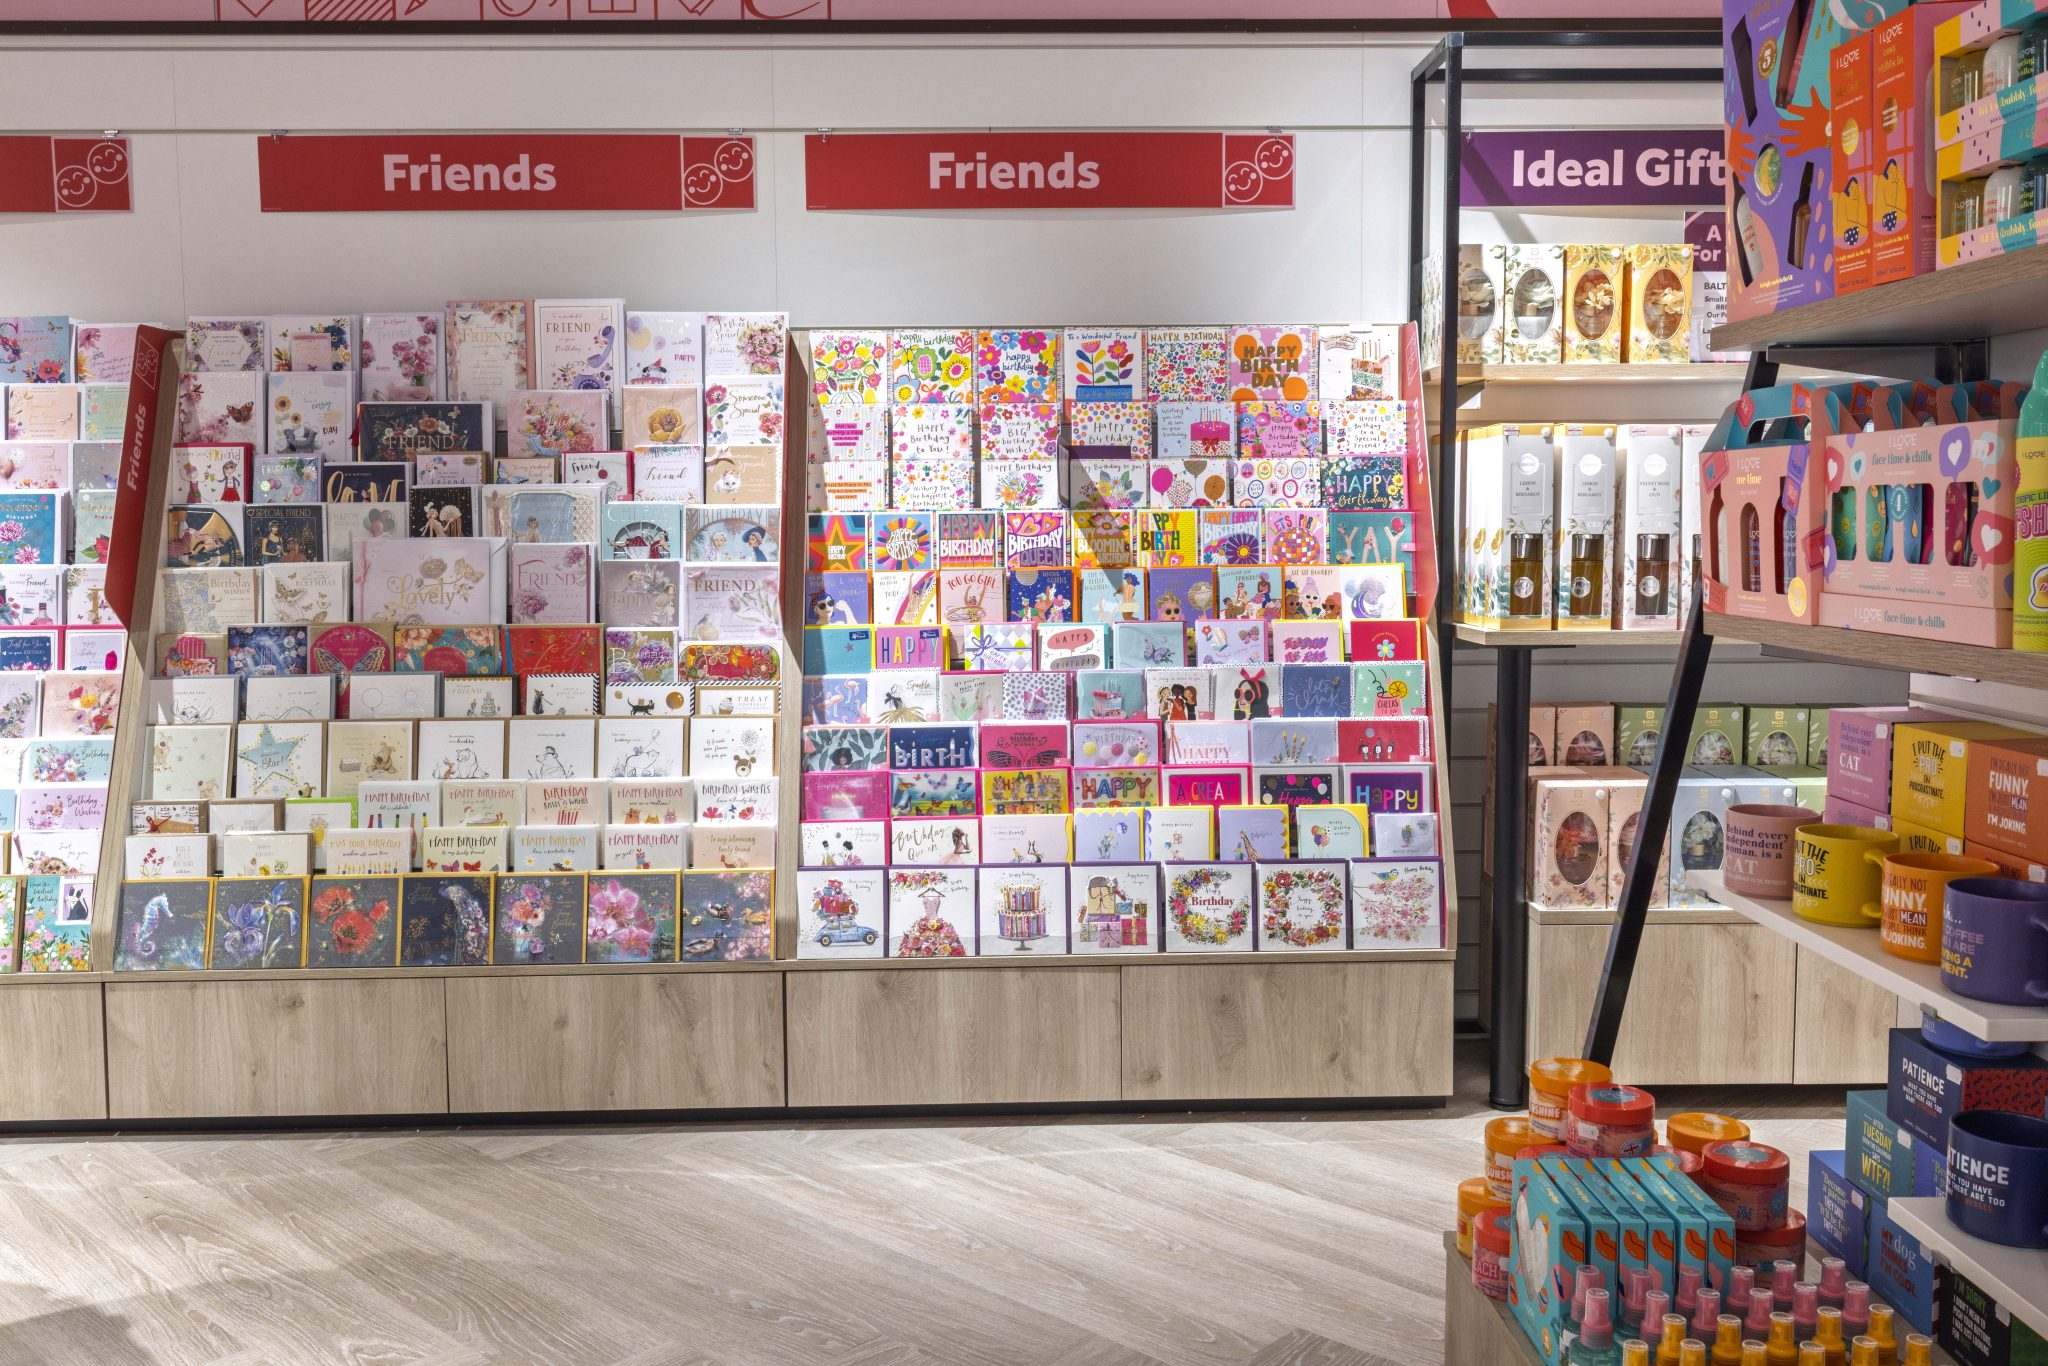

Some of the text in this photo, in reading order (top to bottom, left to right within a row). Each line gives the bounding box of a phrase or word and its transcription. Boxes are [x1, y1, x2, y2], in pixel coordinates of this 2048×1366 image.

[383, 153, 557, 193] Friends
[927, 151, 1101, 192] Friends
[1513, 149, 1624, 187] Ideal
[1706, 224, 1722, 242] A
[546, 322, 591, 333] FRIEND
[899, 333, 956, 346] happy birthday
[1081, 332, 1137, 341] Wonderful Friend
[1150, 331, 1224, 342] HAPPY BIRTHDAY
[674, 354, 695, 362] PARTY
[1005, 352, 1031, 363] happy
[1243, 346, 1297, 357] HAPPY
[1002, 361, 1035, 375] birthday
[1240, 359, 1300, 373] BIRTH
[1251, 373, 1290, 388] DAY
[729, 390, 767, 403] Someone
[730, 402, 761, 419] Special
[322, 426, 338, 435] DAY
[1007, 429, 1027, 438] BIG
[1271, 424, 1293, 434] Happy
[387, 435, 455, 449] FRIEND
[910, 435, 950, 444] Birthday
[1268, 433, 1298, 443] Birthday
[1354, 435, 1380, 443] Special
[126, 403, 148, 491] Friends
[1277, 442, 1297, 453] Lovely
[1872, 450, 1932, 465] face time chills
[572, 460, 601, 475] Friend
[645, 466, 688, 481] Friend
[1015, 463, 1052, 473] Birthday
[1093, 462, 1121, 472] Birthday
[1336, 474, 1393, 493] HAPPY
[1736, 473, 1762, 484] me time
[1338, 490, 1394, 508] Birthday
[255, 508, 311, 517] SPECIAL FRIEND
[1203, 512, 1258, 524] HAPPY HAPPY
[940, 514, 996, 539] HAPPY
[1140, 513, 1179, 531] HAPPY
[1298, 513, 1323, 534] PARTY
[888, 529, 916, 543] HAPPY
[1141, 531, 1180, 550] BIRTH
[1204, 522, 1258, 544] BIRTHDAY
[940, 538, 995, 557] BIRTHDAY
[1008, 526, 1064, 556] BIRTHDAY
[1337, 526, 1406, 564] YAY
[886, 539, 919, 560] BIRTHDAY
[1019, 548, 1063, 566] QUEEN
[1096, 552, 1130, 564] BIRTHDAY
[1141, 551, 1167, 566] DAY
[518, 560, 576, 591] FRIEND
[946, 573, 996, 590] YOU GO GIRL
[211, 578, 251, 592] Birthday
[389, 574, 456, 608] Lovely
[694, 579, 756, 592] FRIEND
[1884, 611, 1946, 628] face time chills
[881, 636, 939, 664] HAPPY
[989, 649, 1007, 662] HAPPY
[906, 680, 931, 691] Sparkle
[1377, 698, 1400, 709] CHEERS
[1840, 722, 1858, 735] Behind
[1094, 733, 1136, 745] BIRTHDAY
[1840, 733, 1872, 748] independent
[82, 749, 111, 761] Birthday
[894, 747, 966, 768] BIRTH
[1183, 746, 1232, 759] HAPPY
[1912, 740, 1946, 761] I PUT THE
[1839, 752, 1861, 771] CAT
[1919, 756, 1937, 777] PRO
[1923, 774, 1931, 784] IN
[1989, 770, 2029, 798] FUNNY.
[450, 788, 515, 800] HAPPY BIRTHDAY
[543, 787, 589, 799] BIRTHDAY
[617, 787, 683, 800] HAPPY BIRTHDAY
[702, 784, 771, 796] BIRTHDAY WISHES
[1081, 777, 1153, 800] HAPPY
[1176, 781, 1235, 801] A GREAT
[1909, 780, 1945, 800] PROCRASTINATE.
[66, 795, 98, 808] Birthday
[365, 791, 430, 804] HAPPY BIRTHDAY
[1278, 791, 1315, 807] Happy
[1356, 785, 1420, 810] Happy
[2011, 796, 2028, 812] MEAN
[75, 805, 101, 816] Wishes
[1987, 812, 2027, 834] I'M JOKING.
[608, 834, 680, 847] HAPPY BIRTHDAY
[893, 828, 946, 850] Birthday
[1726, 824, 1791, 842] Behind every
[368, 838, 401, 849] BIRTHDAY
[429, 835, 497, 848] HAPPY BIRTHDAY
[521, 835, 587, 847] HAPPY BIRTHDAY
[1914, 835, 1942, 854] PUT THE
[907, 842, 938, 863] Queen
[1761, 849, 1772, 859] is
[1807, 842, 1830, 864] THE
[1725, 855, 1759, 875] CAT
[1795, 855, 1815, 876] PRO
[1910, 878, 1928, 892] NOT
[1191, 896, 1235, 908] Birthday
[1900, 910, 1926, 926] MEAN
[1903, 925, 1928, 937] THINK
[1945, 924, 1985, 945] COFFEE
[1886, 931, 1928, 950] JOKING.
[1953, 940, 1976, 955] ARE
[1962, 956, 1973, 968] A
[1902, 1057, 1945, 1097] PATIENCE
[1918, 1086, 1927, 1097] YOU
[1925, 1098, 1934, 1109] ARE
[1863, 1120, 1893, 1152] TUESDAY
[1861, 1152, 1891, 1192] WTF?!
[1957, 1176, 1993, 1195] YOU HAVE
[1951, 1181, 1968, 1196] THERE
[1970, 1191, 1985, 1202] ARE
[1988, 1196, 2006, 1208] TOO
[1824, 1196, 1834, 1211] THEY
[1823, 1218, 1833, 1233] THEY
[1894, 1235, 1917, 1271] dog
[1966, 1285, 1987, 1314] SORRY
